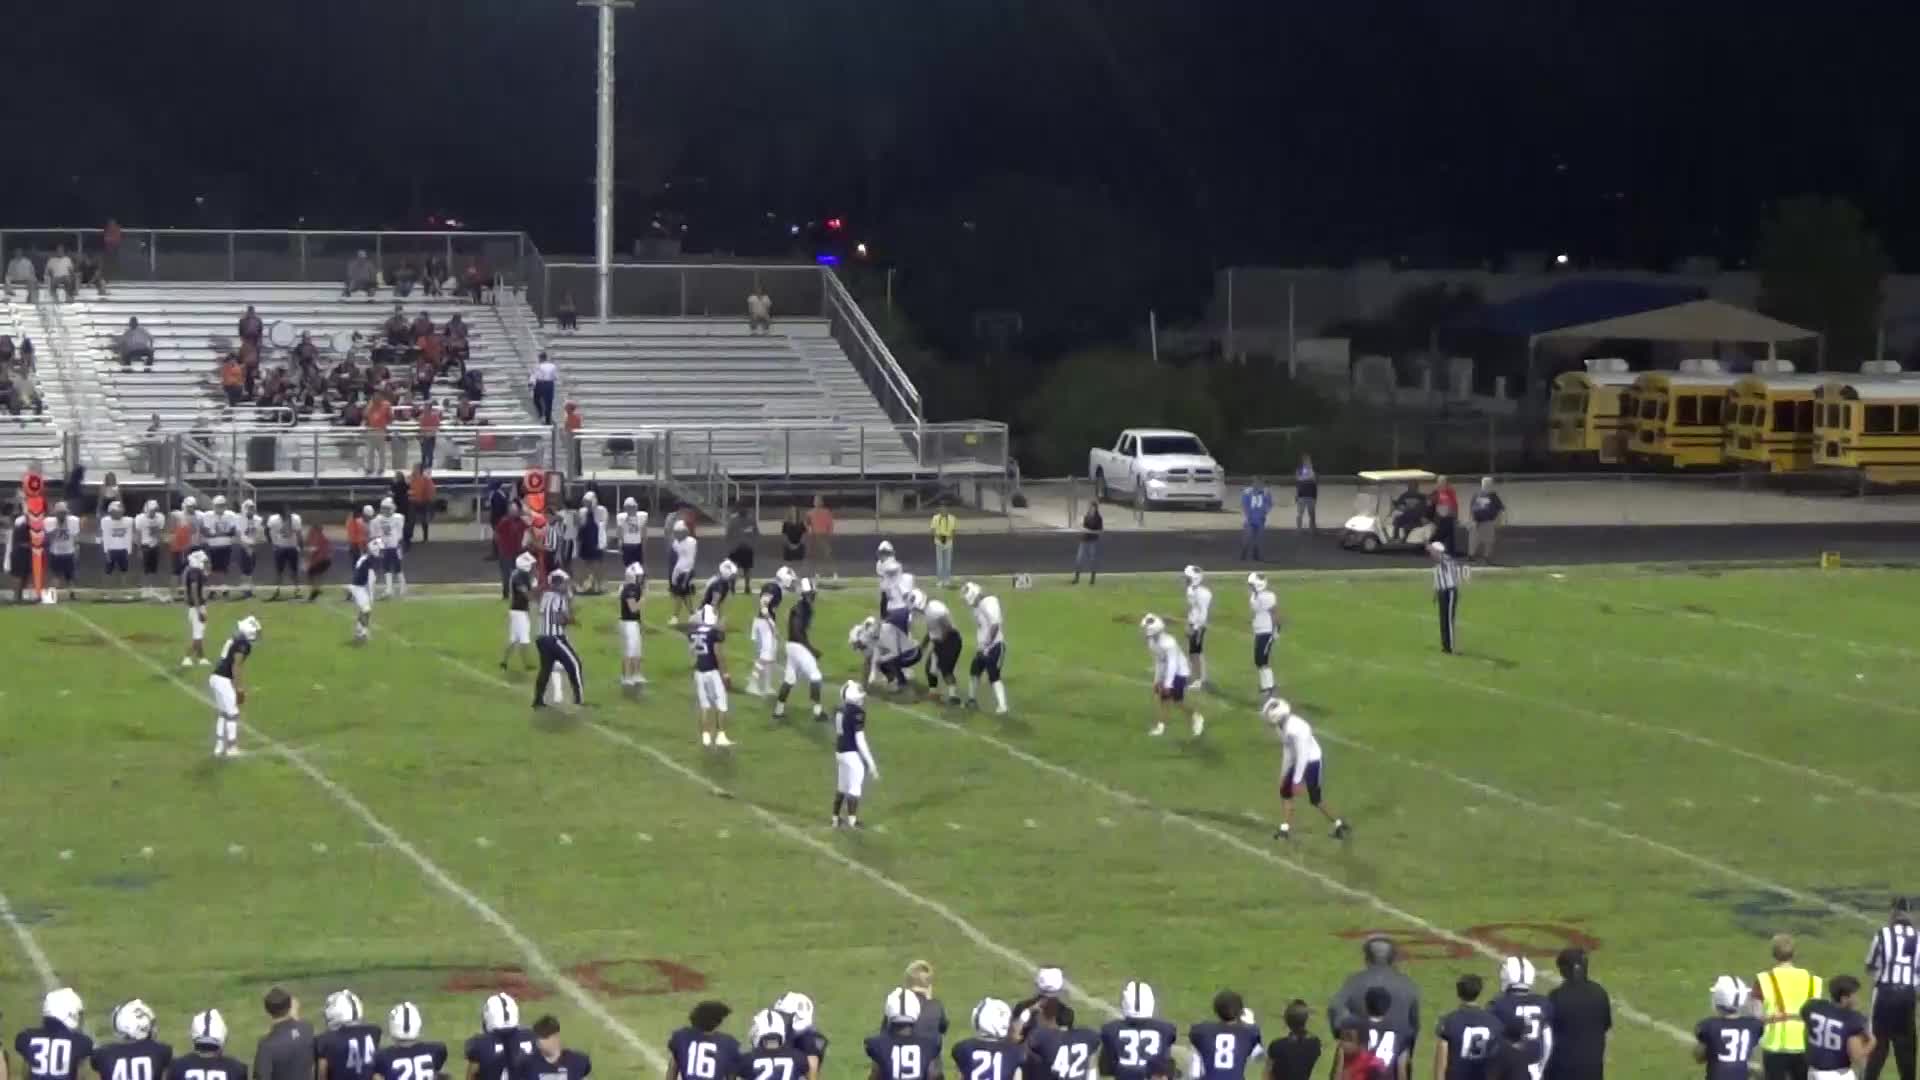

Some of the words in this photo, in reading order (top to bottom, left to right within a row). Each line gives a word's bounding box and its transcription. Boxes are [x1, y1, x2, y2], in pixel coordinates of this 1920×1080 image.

[1515, 1006, 1541, 1039] 5
[1808, 1013, 1844, 1050] 36
[30, 1038, 71, 1075] 30
[687, 1041, 716, 1078] 16
[891, 1044, 921, 1079] 19
[1052, 1043, 1087, 1078] 42
[1214, 1033, 1235, 1069] 8
[1718, 1029, 1750, 1062] 31
[112, 1057, 152, 1080] 40
[392, 1055, 433, 1080] 26
[753, 1057, 793, 1080] 27
[972, 1051, 1002, 1080] 21
